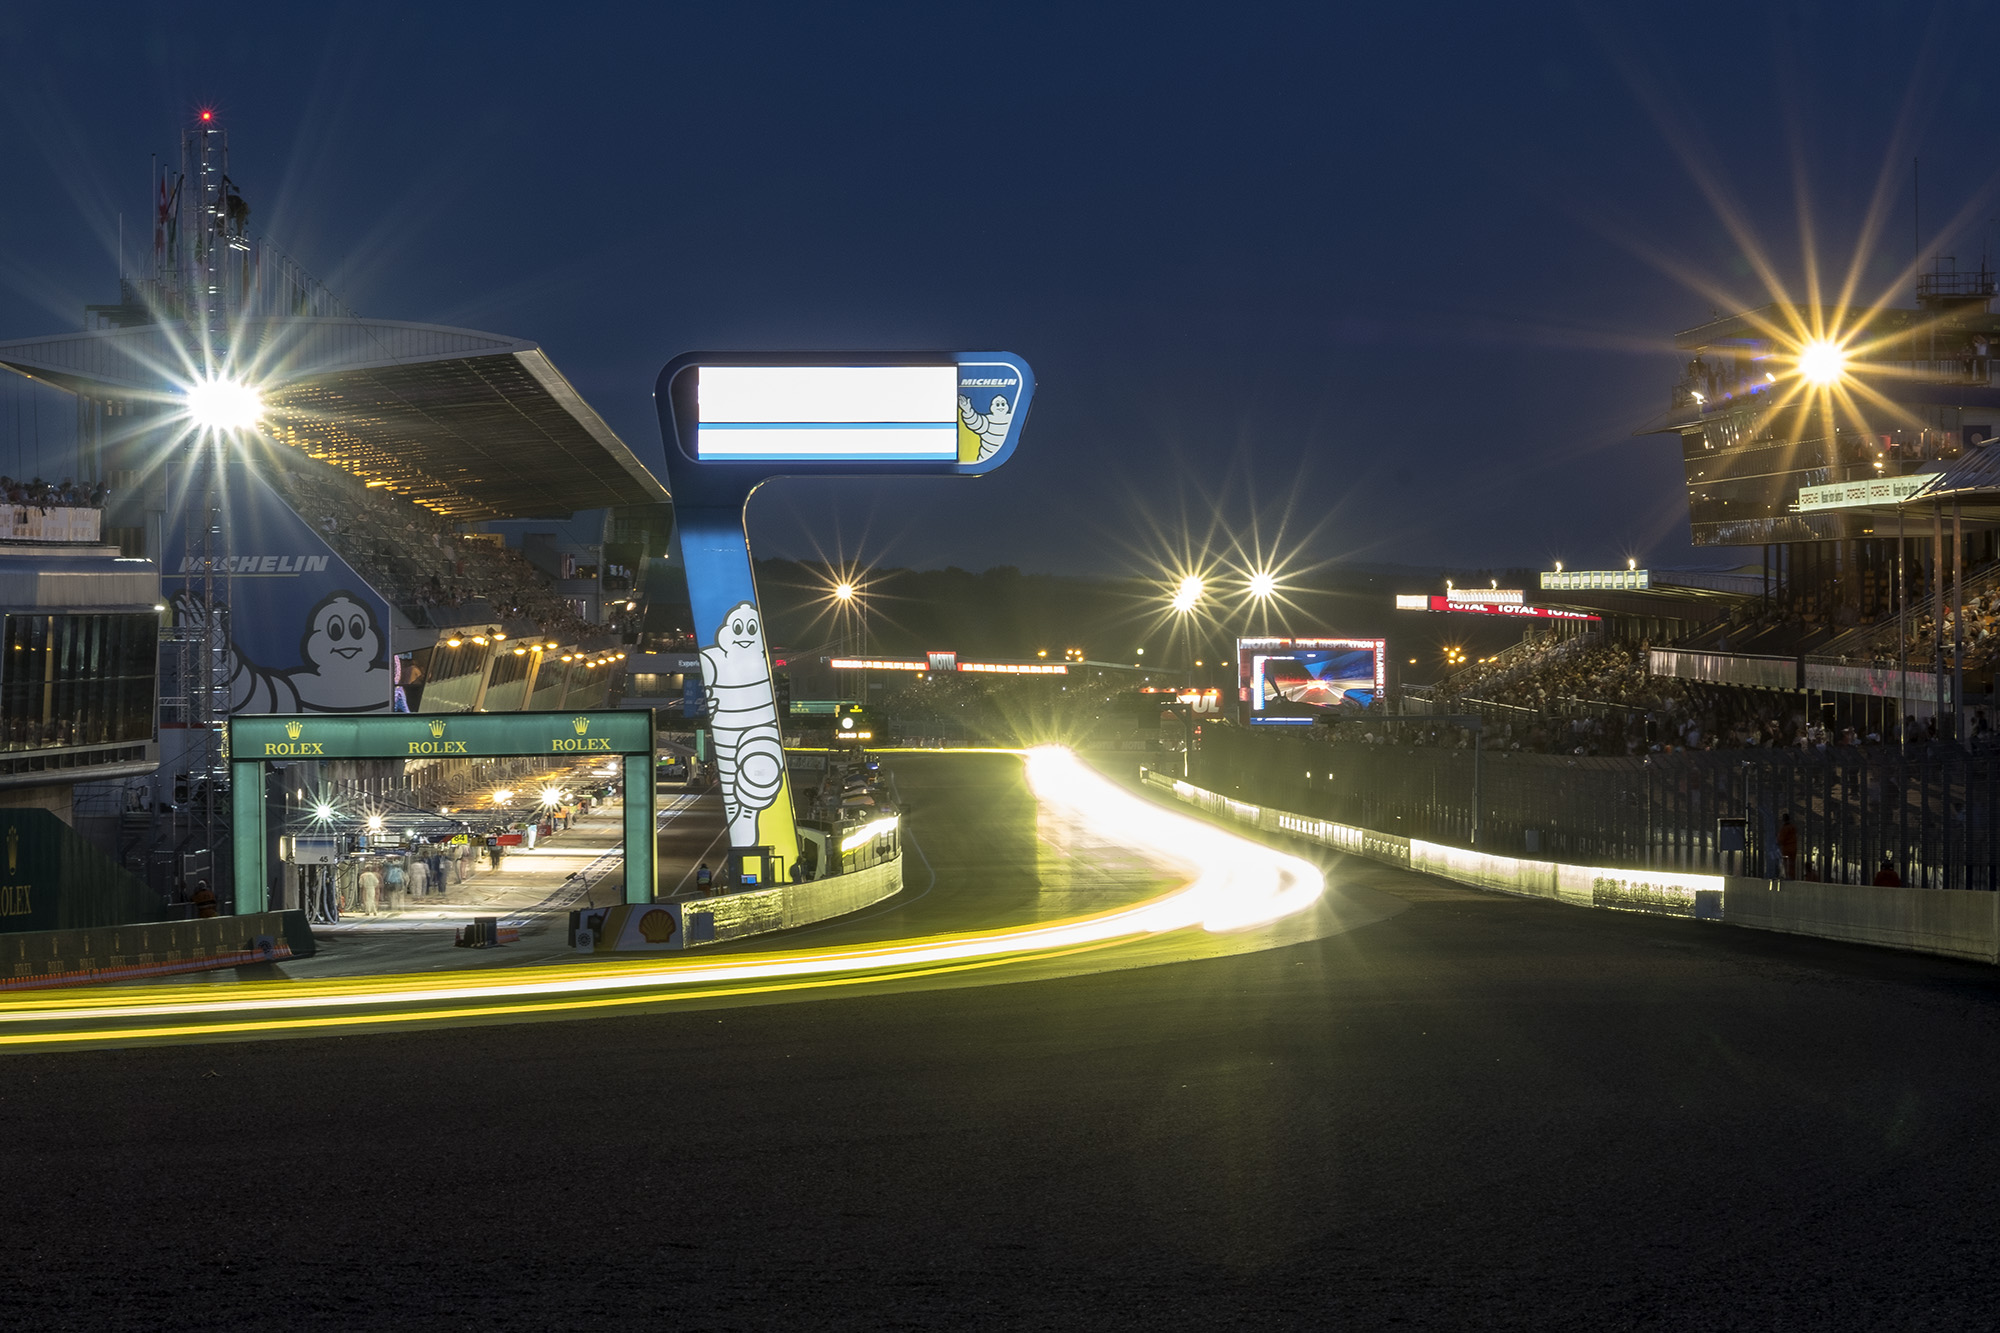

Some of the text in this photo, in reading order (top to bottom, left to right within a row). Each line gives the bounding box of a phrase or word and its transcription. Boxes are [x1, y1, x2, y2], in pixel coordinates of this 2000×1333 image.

[178, 555, 329, 573] MICHELIN
[929, 653, 957, 670] MOTUL
[264, 738, 611, 755] ROLEX ROLEX ROLEX
[0, 885, 32, 917] OLEX
